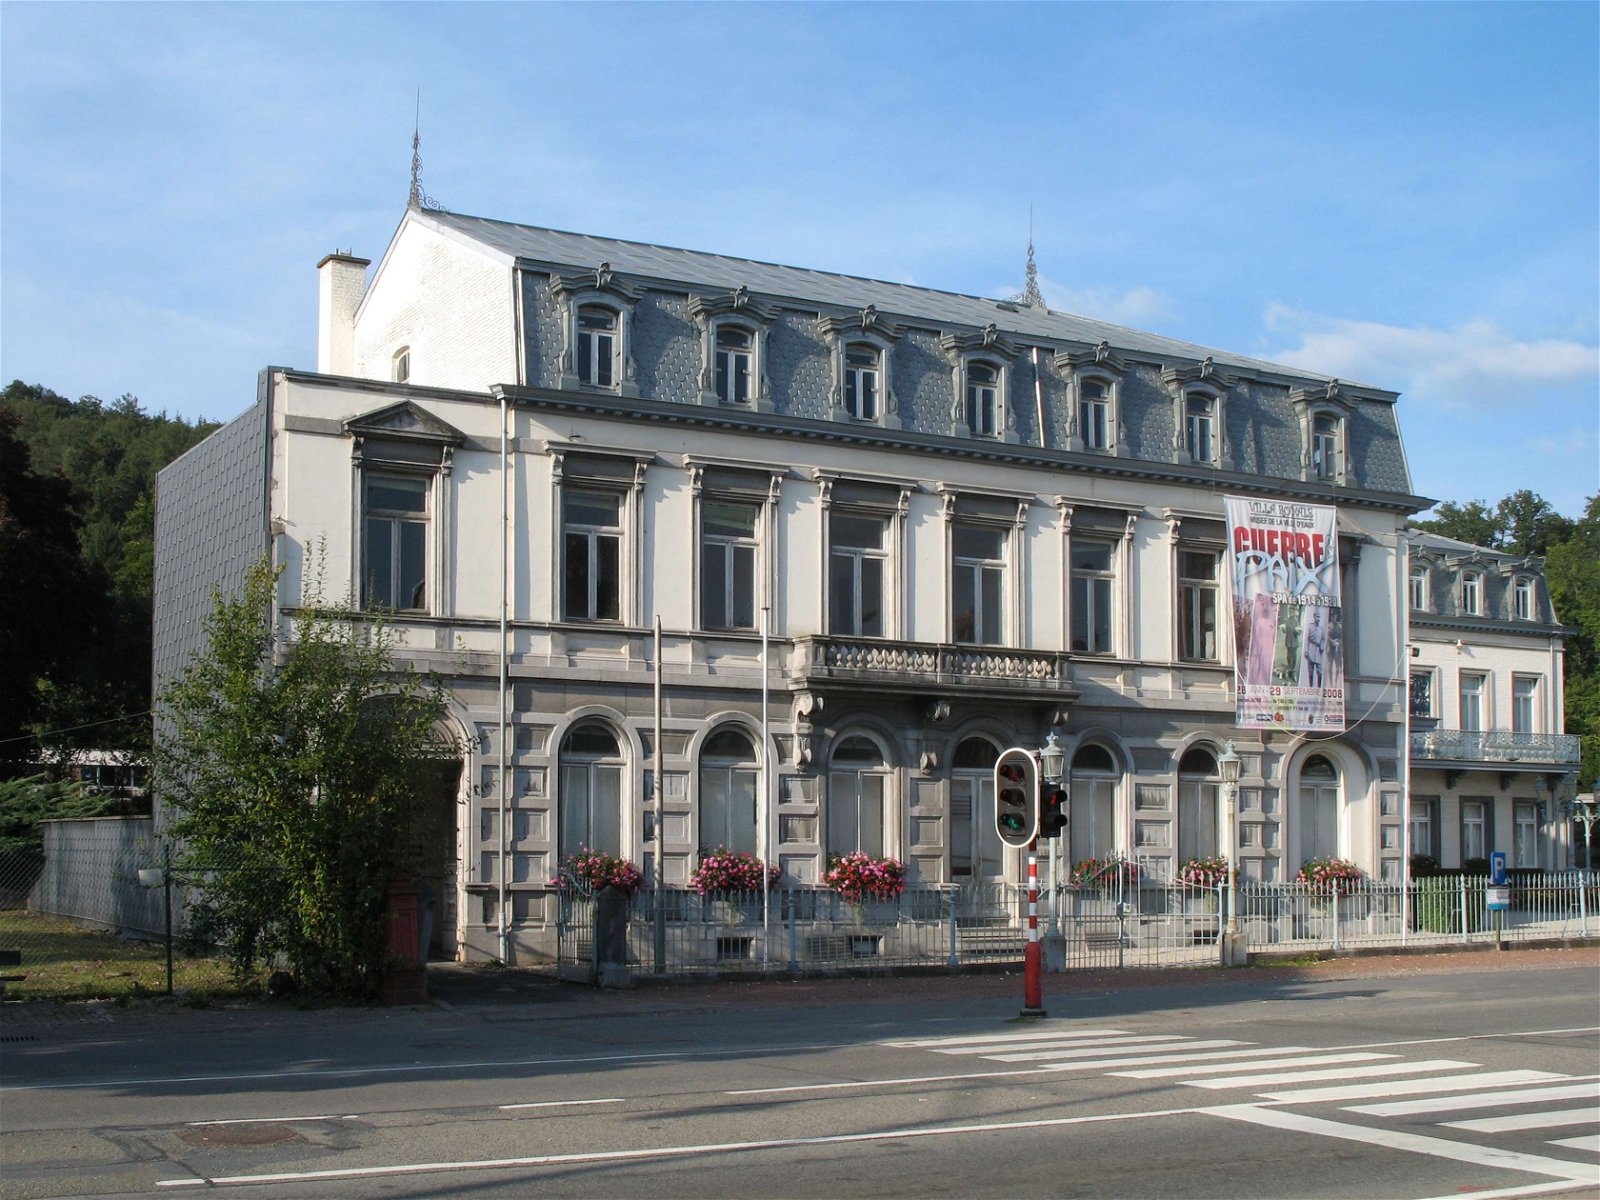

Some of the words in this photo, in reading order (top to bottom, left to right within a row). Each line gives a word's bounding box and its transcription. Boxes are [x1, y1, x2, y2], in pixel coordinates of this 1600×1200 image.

[1248, 502, 1276, 514] VILLA
[1276, 518, 1283, 526] LA
[1234, 526, 1324, 570] GUERRE
[1237, 550, 1336, 600] PAIX
[1272, 593, 1287, 604] SPA
[1297, 594, 1316, 606] 1914
[1237, 685, 1246, 695] 28
[1270, 686, 1281, 696] 29
[1282, 687, 1321, 697] SEPTEMBRE
[1322, 689, 1343, 699] 2008
[1495, 857, 1504, 879] P
